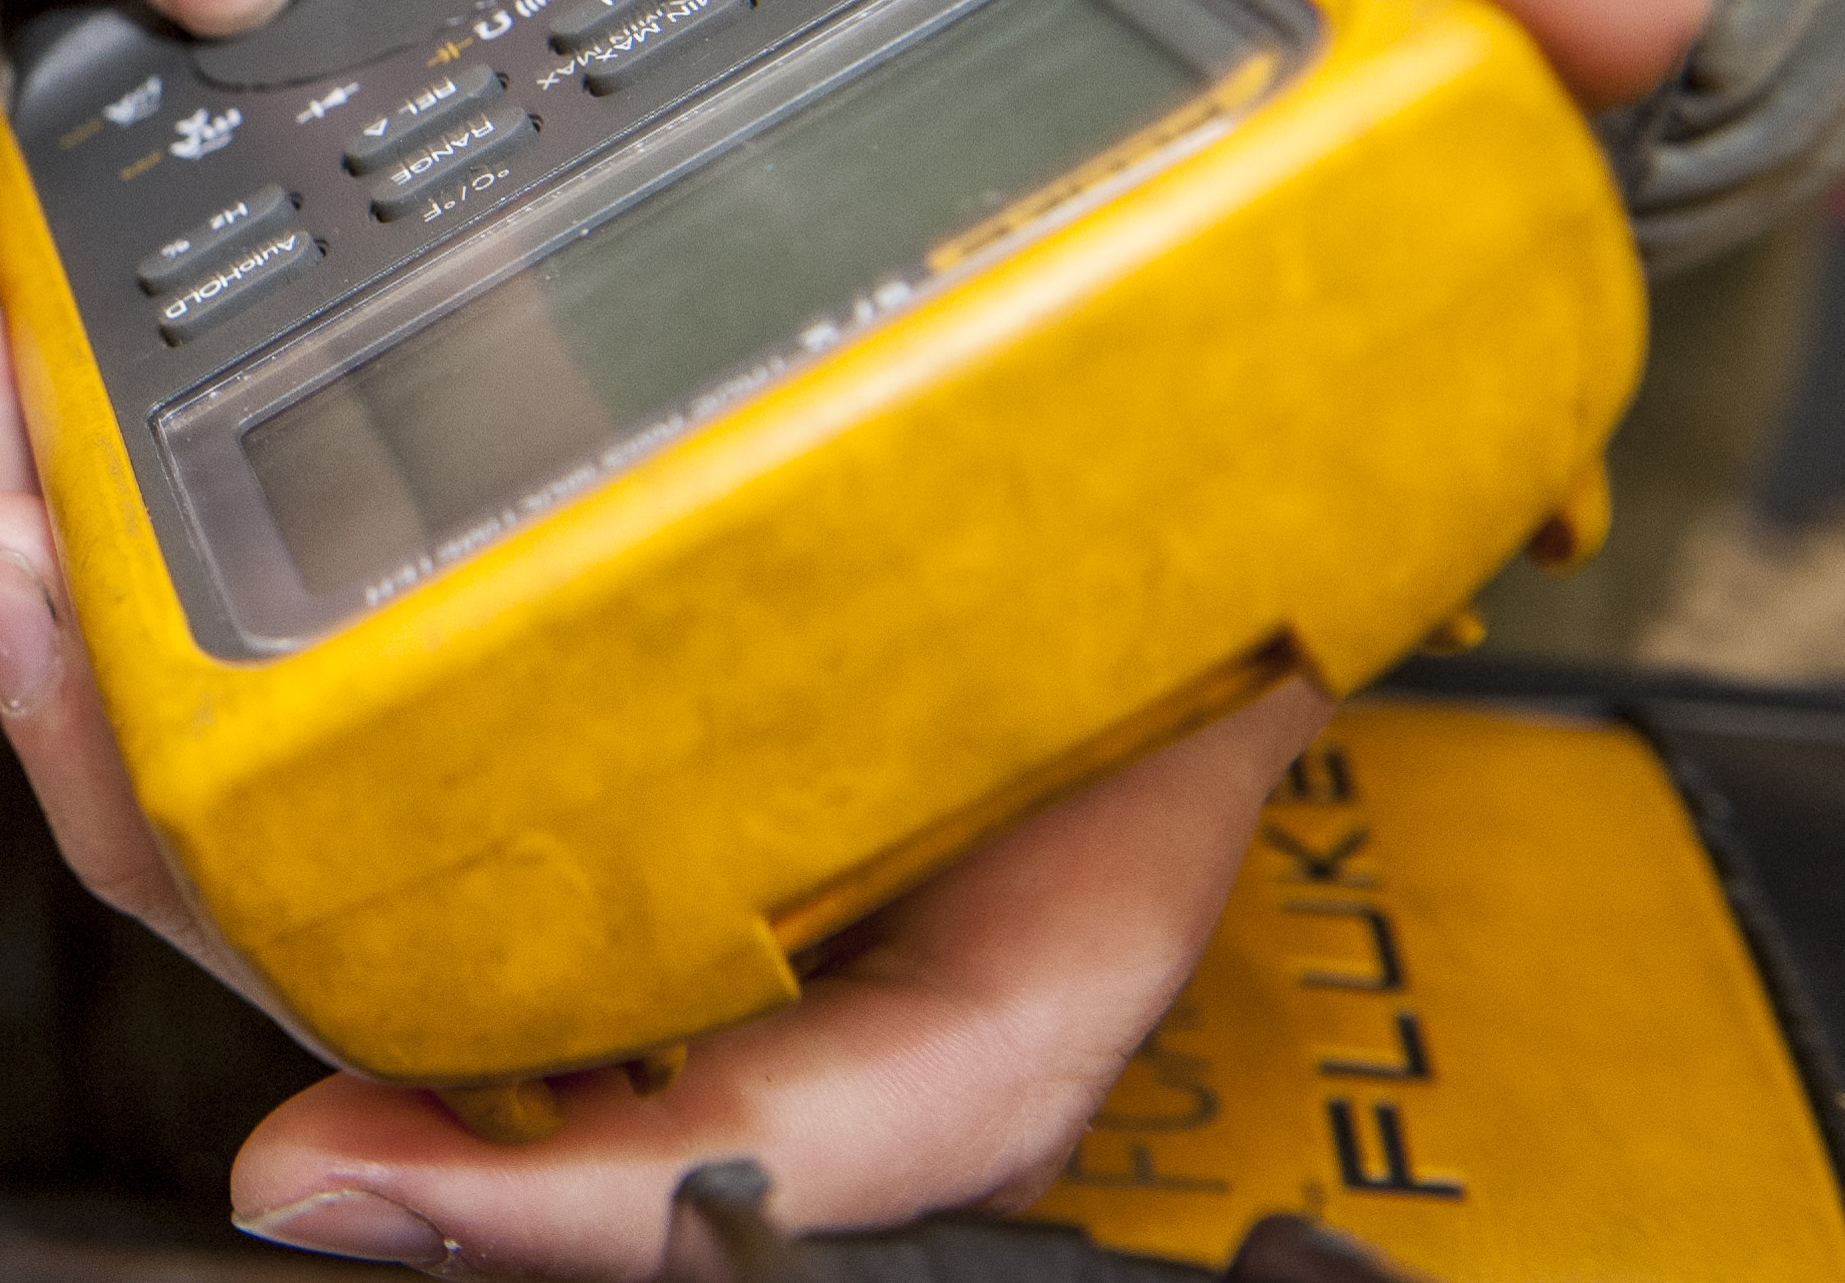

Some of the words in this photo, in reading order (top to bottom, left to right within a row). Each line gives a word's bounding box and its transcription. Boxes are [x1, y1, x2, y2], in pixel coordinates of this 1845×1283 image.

[595, 21, 662, 62] MAX
[399, 80, 458, 116] REL
[391, 119, 496, 186] RANGE
[165, 234, 297, 320] AutoHOLD
[1261, 742, 1469, 1202] FLUKE
